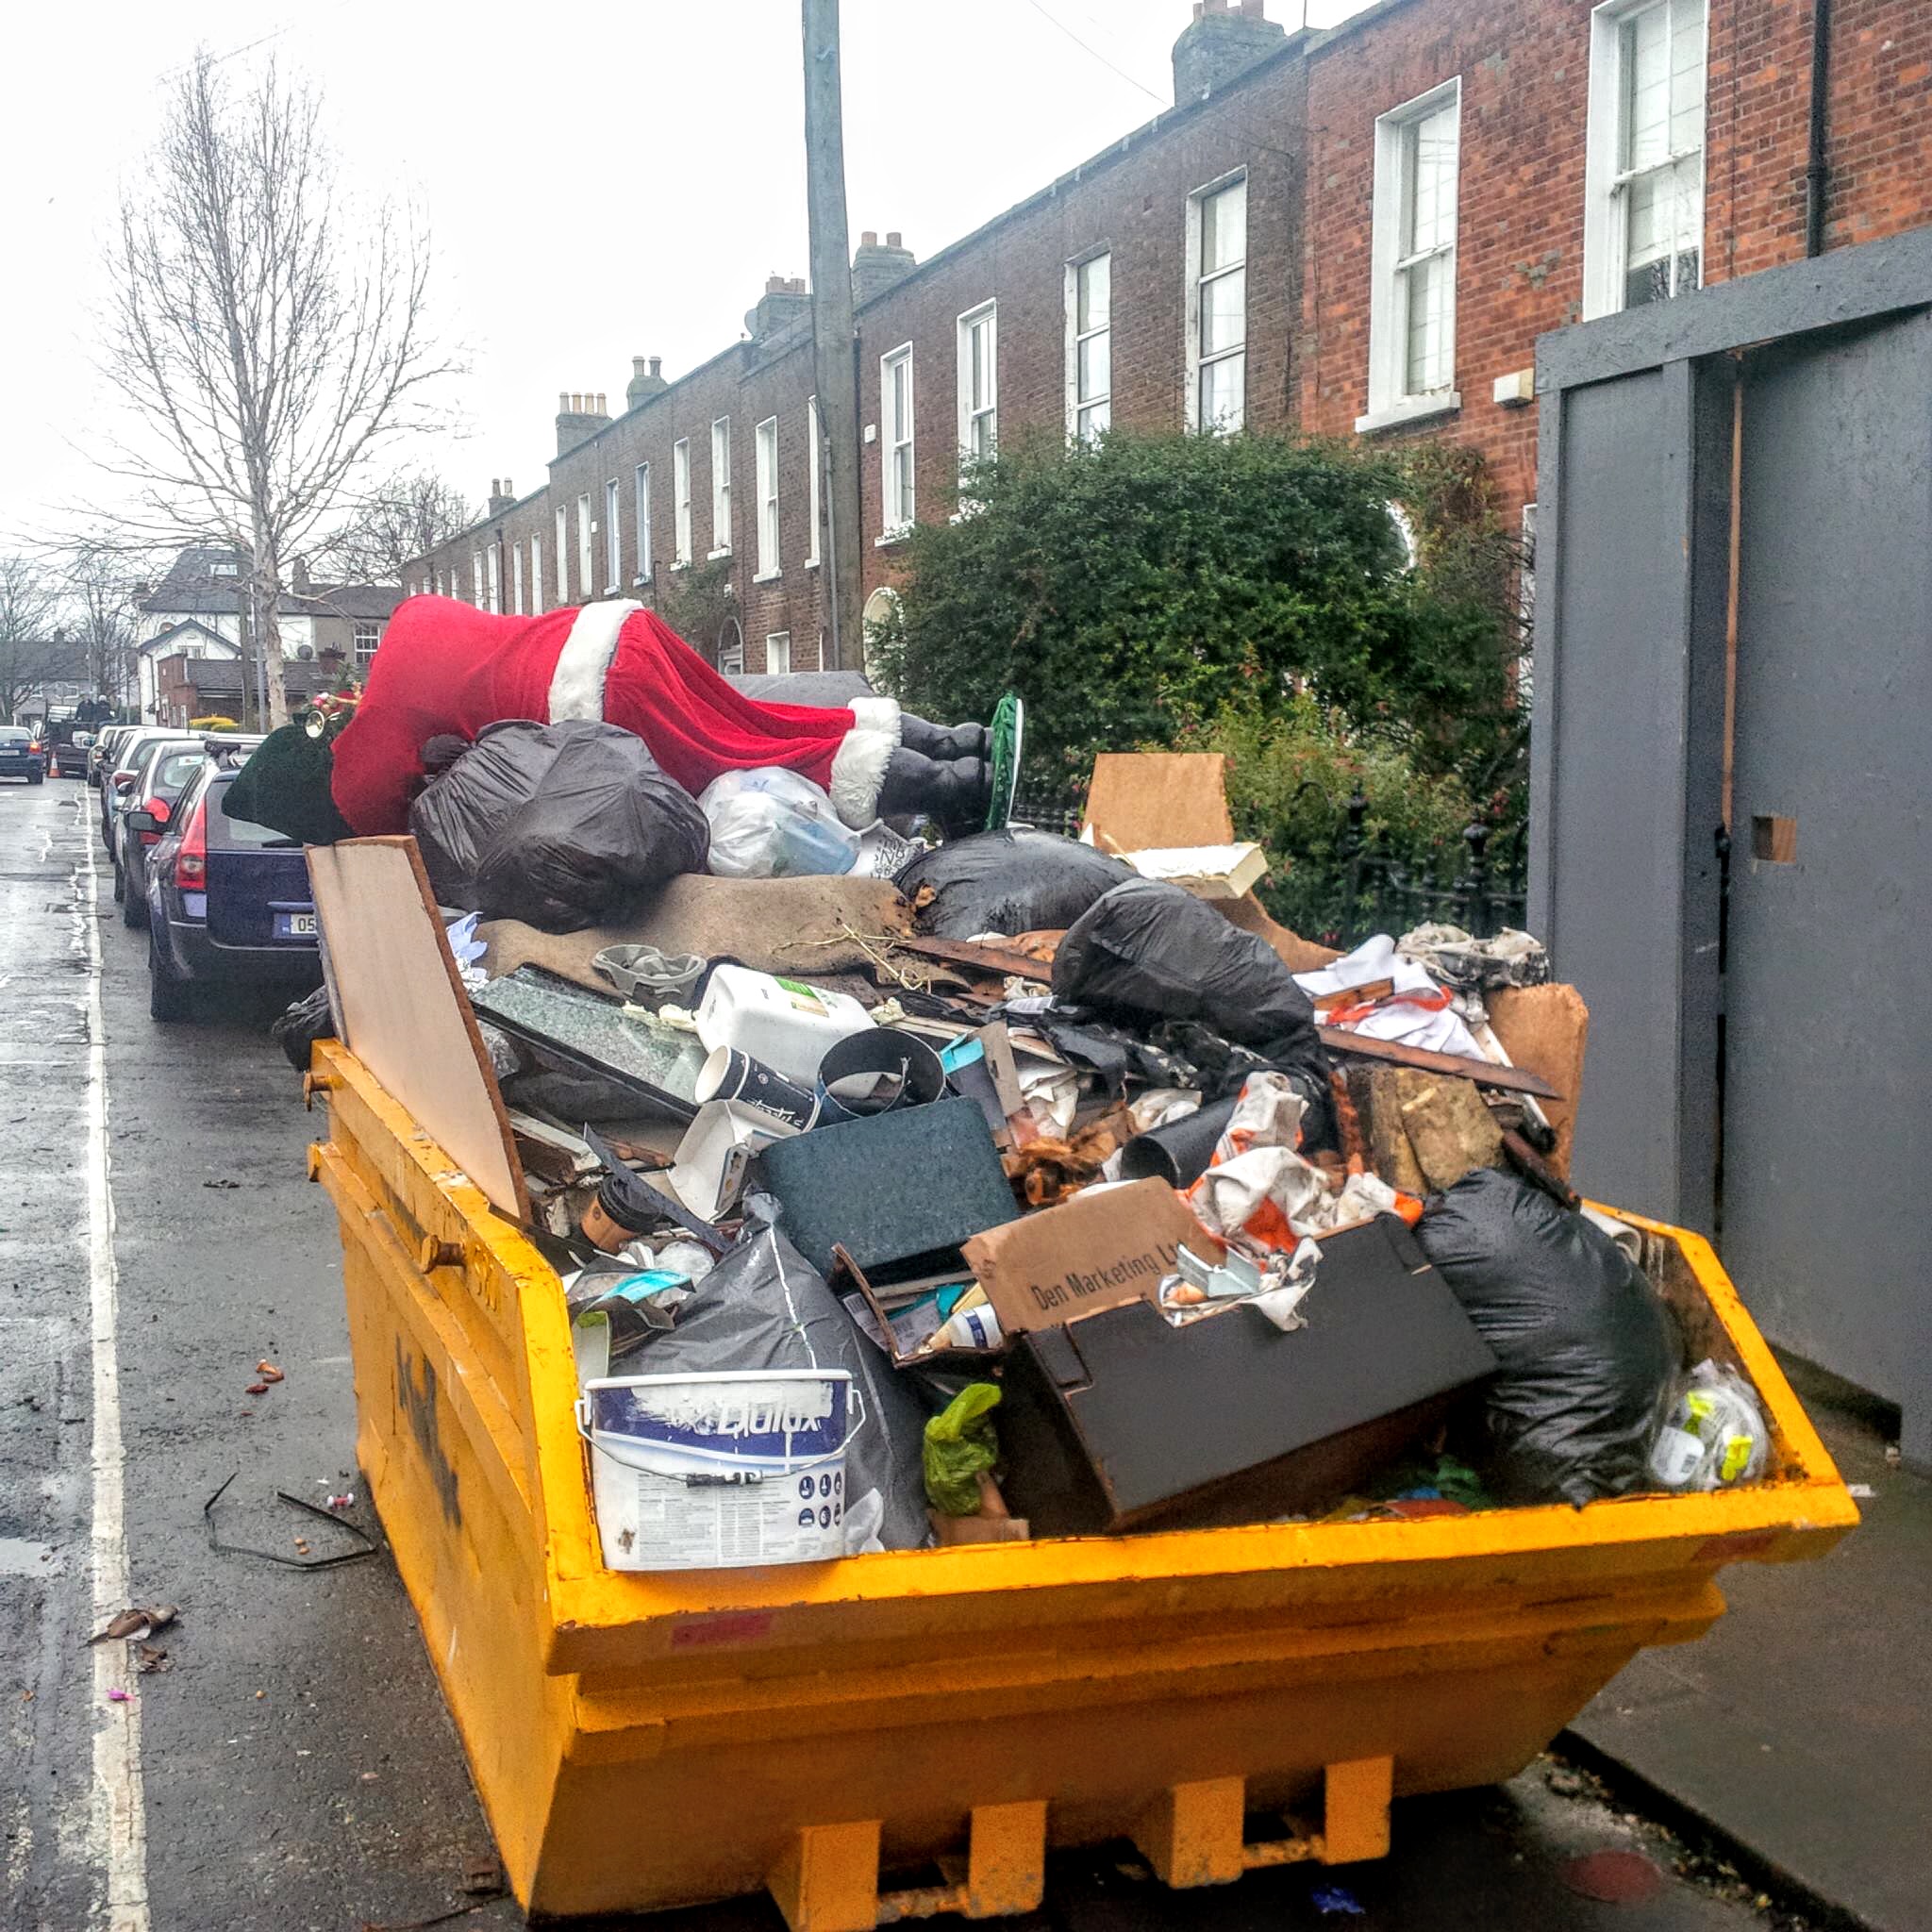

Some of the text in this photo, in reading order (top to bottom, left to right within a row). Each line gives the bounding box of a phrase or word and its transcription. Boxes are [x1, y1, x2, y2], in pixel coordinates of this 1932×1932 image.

[1030, 1243, 1179, 1310] Den Marketing Lt
